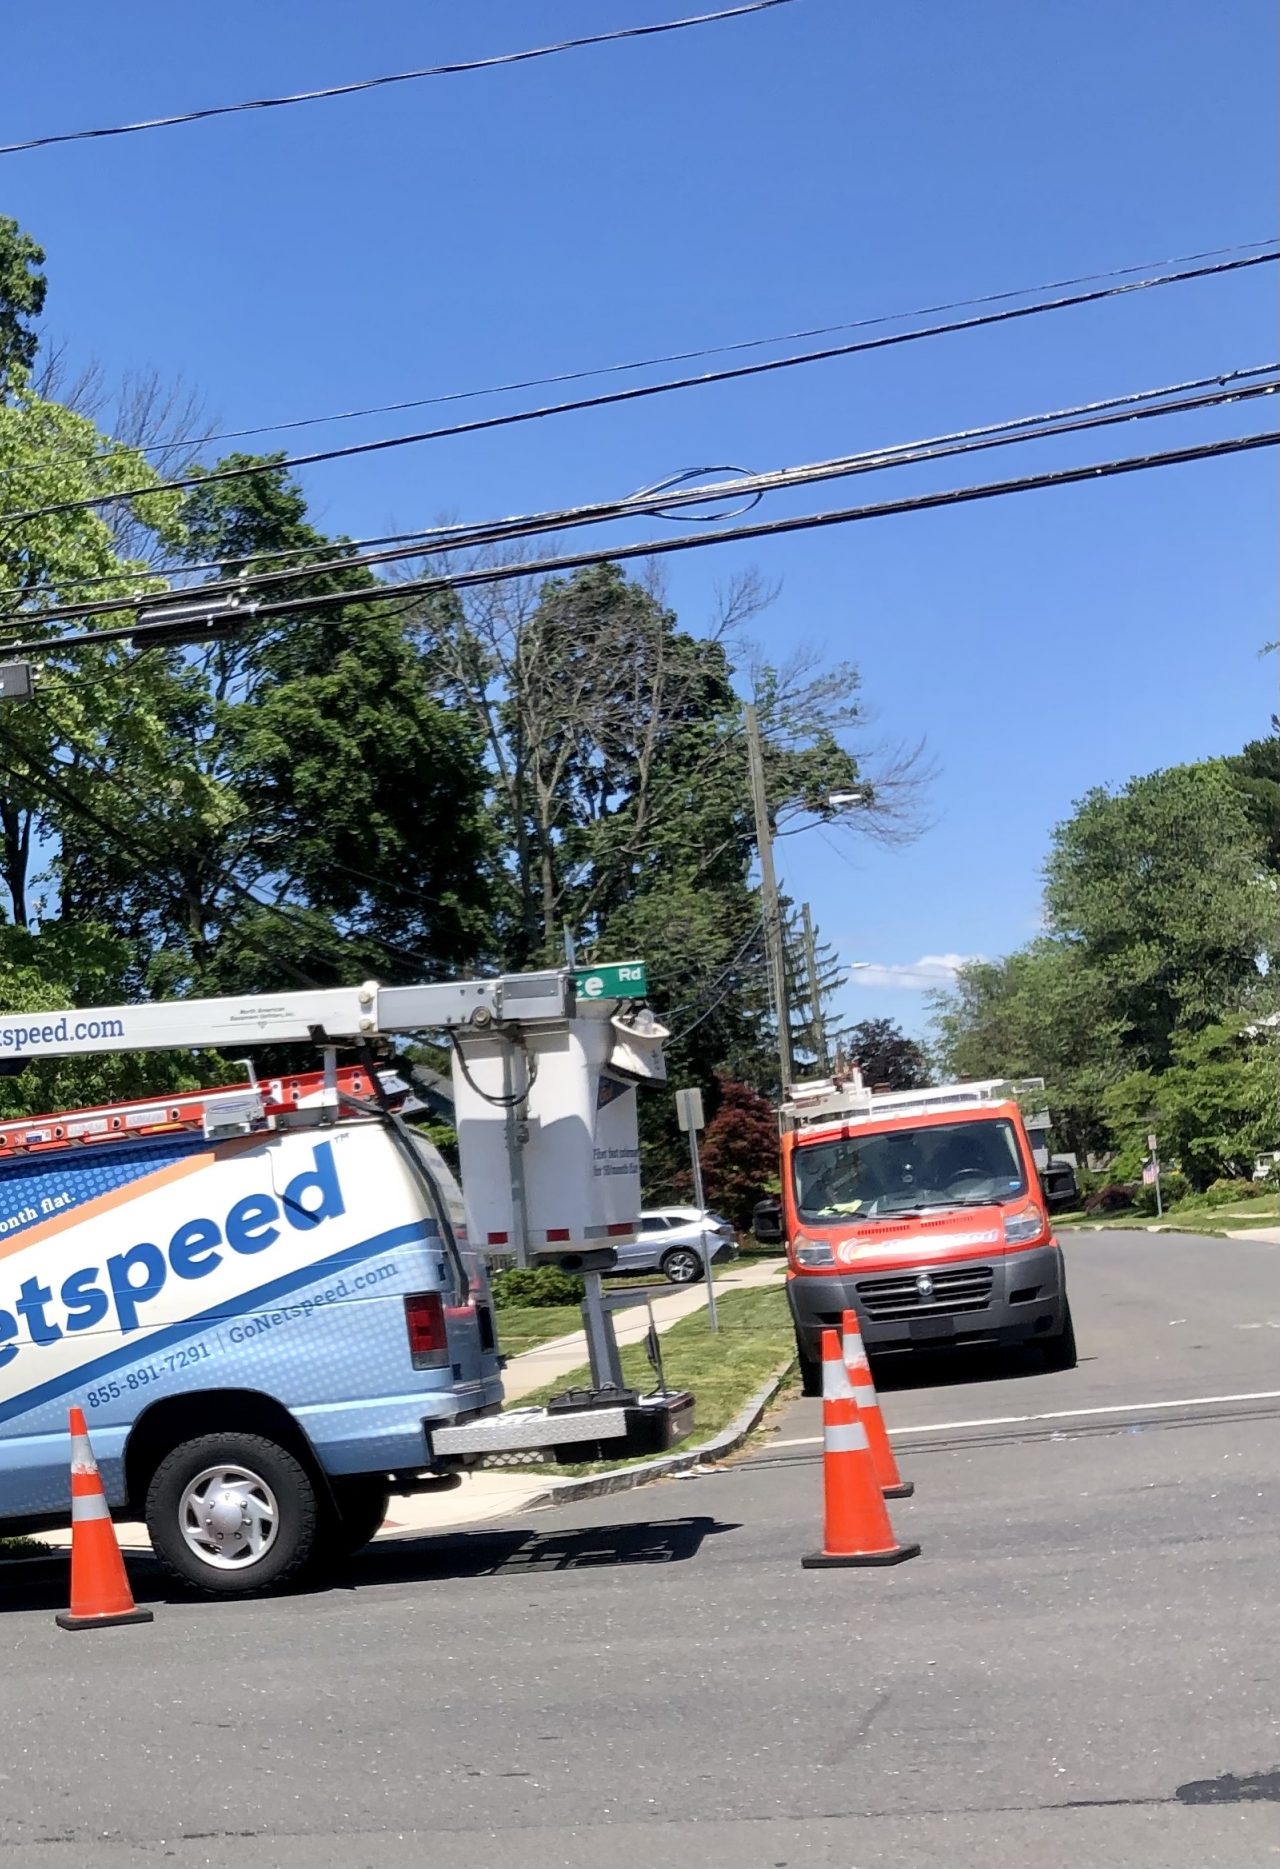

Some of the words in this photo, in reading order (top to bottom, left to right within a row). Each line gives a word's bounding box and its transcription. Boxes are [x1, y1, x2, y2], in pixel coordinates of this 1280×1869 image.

[618, 966, 642, 982] Rd
[40, 1191, 77, 1214] flat.
[86, 1341, 212, 1408] 855-891-7291
[228, 1261, 399, 1344] GoNetspeed.com
